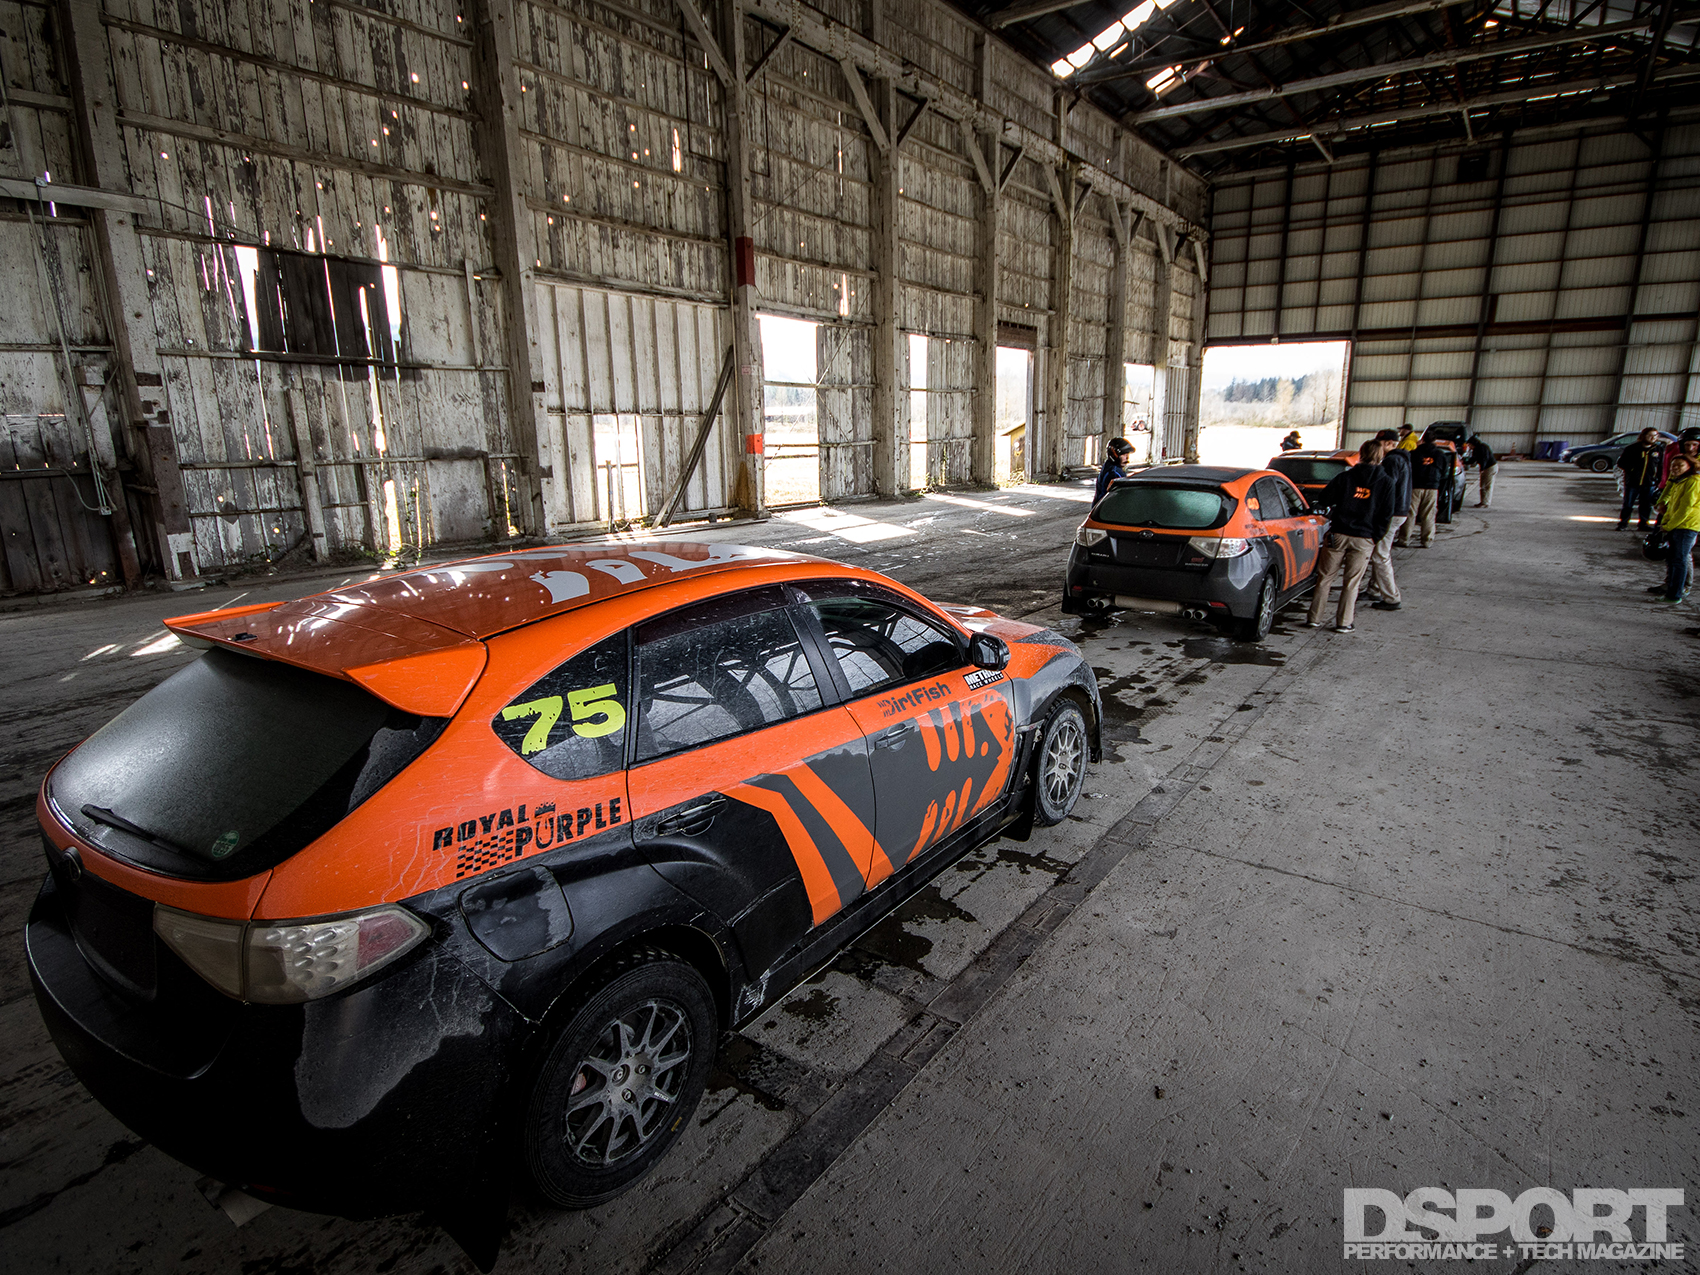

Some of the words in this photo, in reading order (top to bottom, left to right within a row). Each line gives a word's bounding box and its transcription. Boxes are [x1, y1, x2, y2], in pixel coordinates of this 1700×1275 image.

[501, 682, 626, 755] 75
[876, 682, 952, 717] DirtFish
[432, 804, 530, 851] ROYAL
[514, 797, 622, 858] PURPLE
